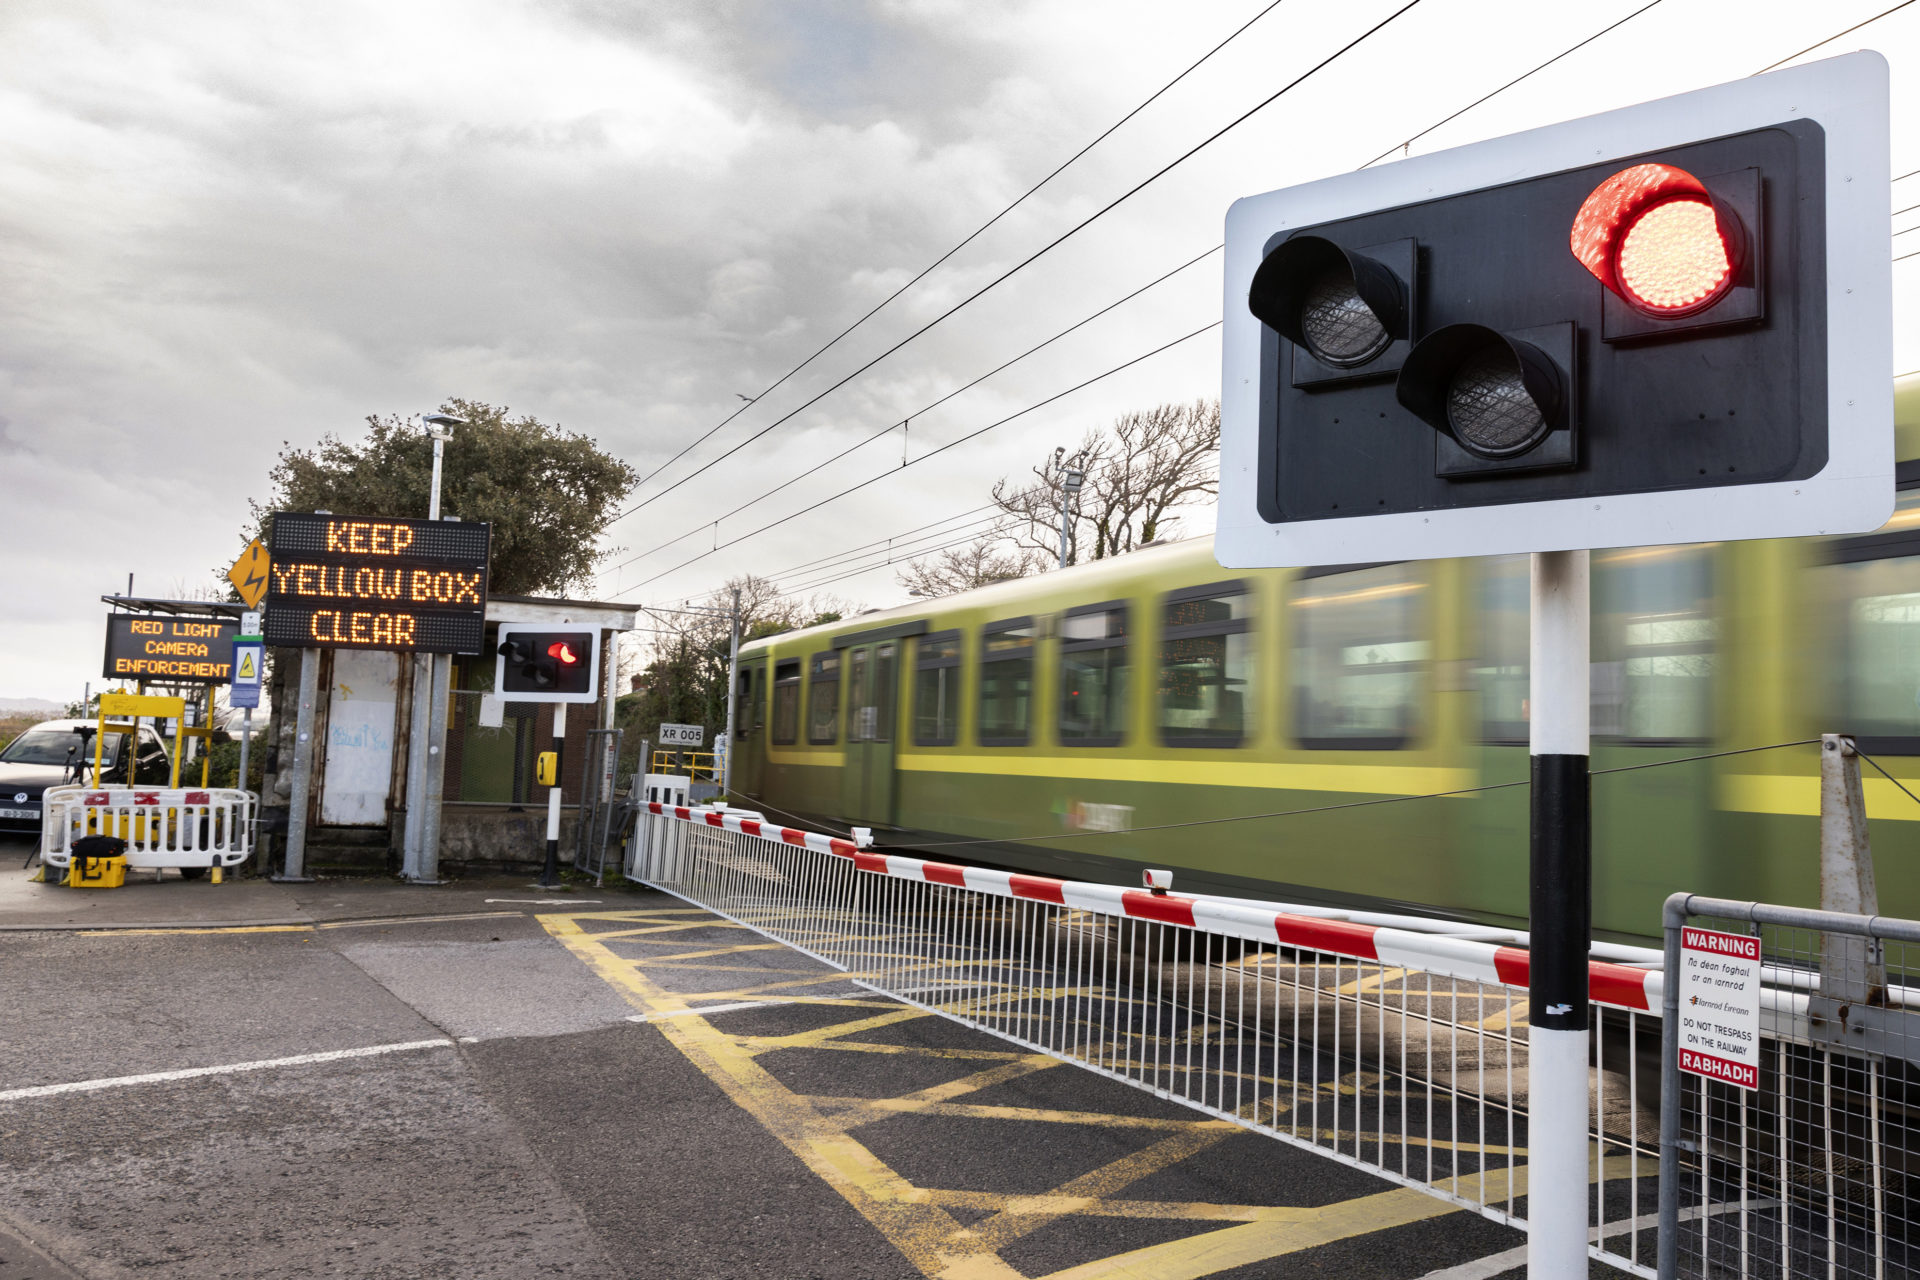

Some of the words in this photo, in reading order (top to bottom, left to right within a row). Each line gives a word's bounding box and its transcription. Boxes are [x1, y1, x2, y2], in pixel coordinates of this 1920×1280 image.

[327, 521, 413, 555] KEEP
[272, 562, 402, 600] YELLOW
[411, 570, 480, 604] BOX
[131, 620, 163, 635] RED
[172, 622, 222, 638] LIGHT
[311, 609, 416, 645] CLEAR
[145, 640, 209, 657] CAMERA
[115, 658, 232, 677] ENFORCEMENT
[662, 729, 676, 738] XR
[680, 730, 701, 740] 005
[1686, 931, 1756, 956] WARNING
[1691, 974, 1700, 982] ar
[1702, 976, 1712, 985] an
[1683, 1017, 1694, 1028] DO
[1696, 1020, 1712, 1032] NOT
[1714, 1024, 1752, 1042] TRESPASS
[1687, 1033, 1699, 1044] ON
[1701, 1036, 1715, 1048] THE
[1717, 1040, 1748, 1056] RAILWAY
[1682, 1052, 1753, 1084] RABHADH
